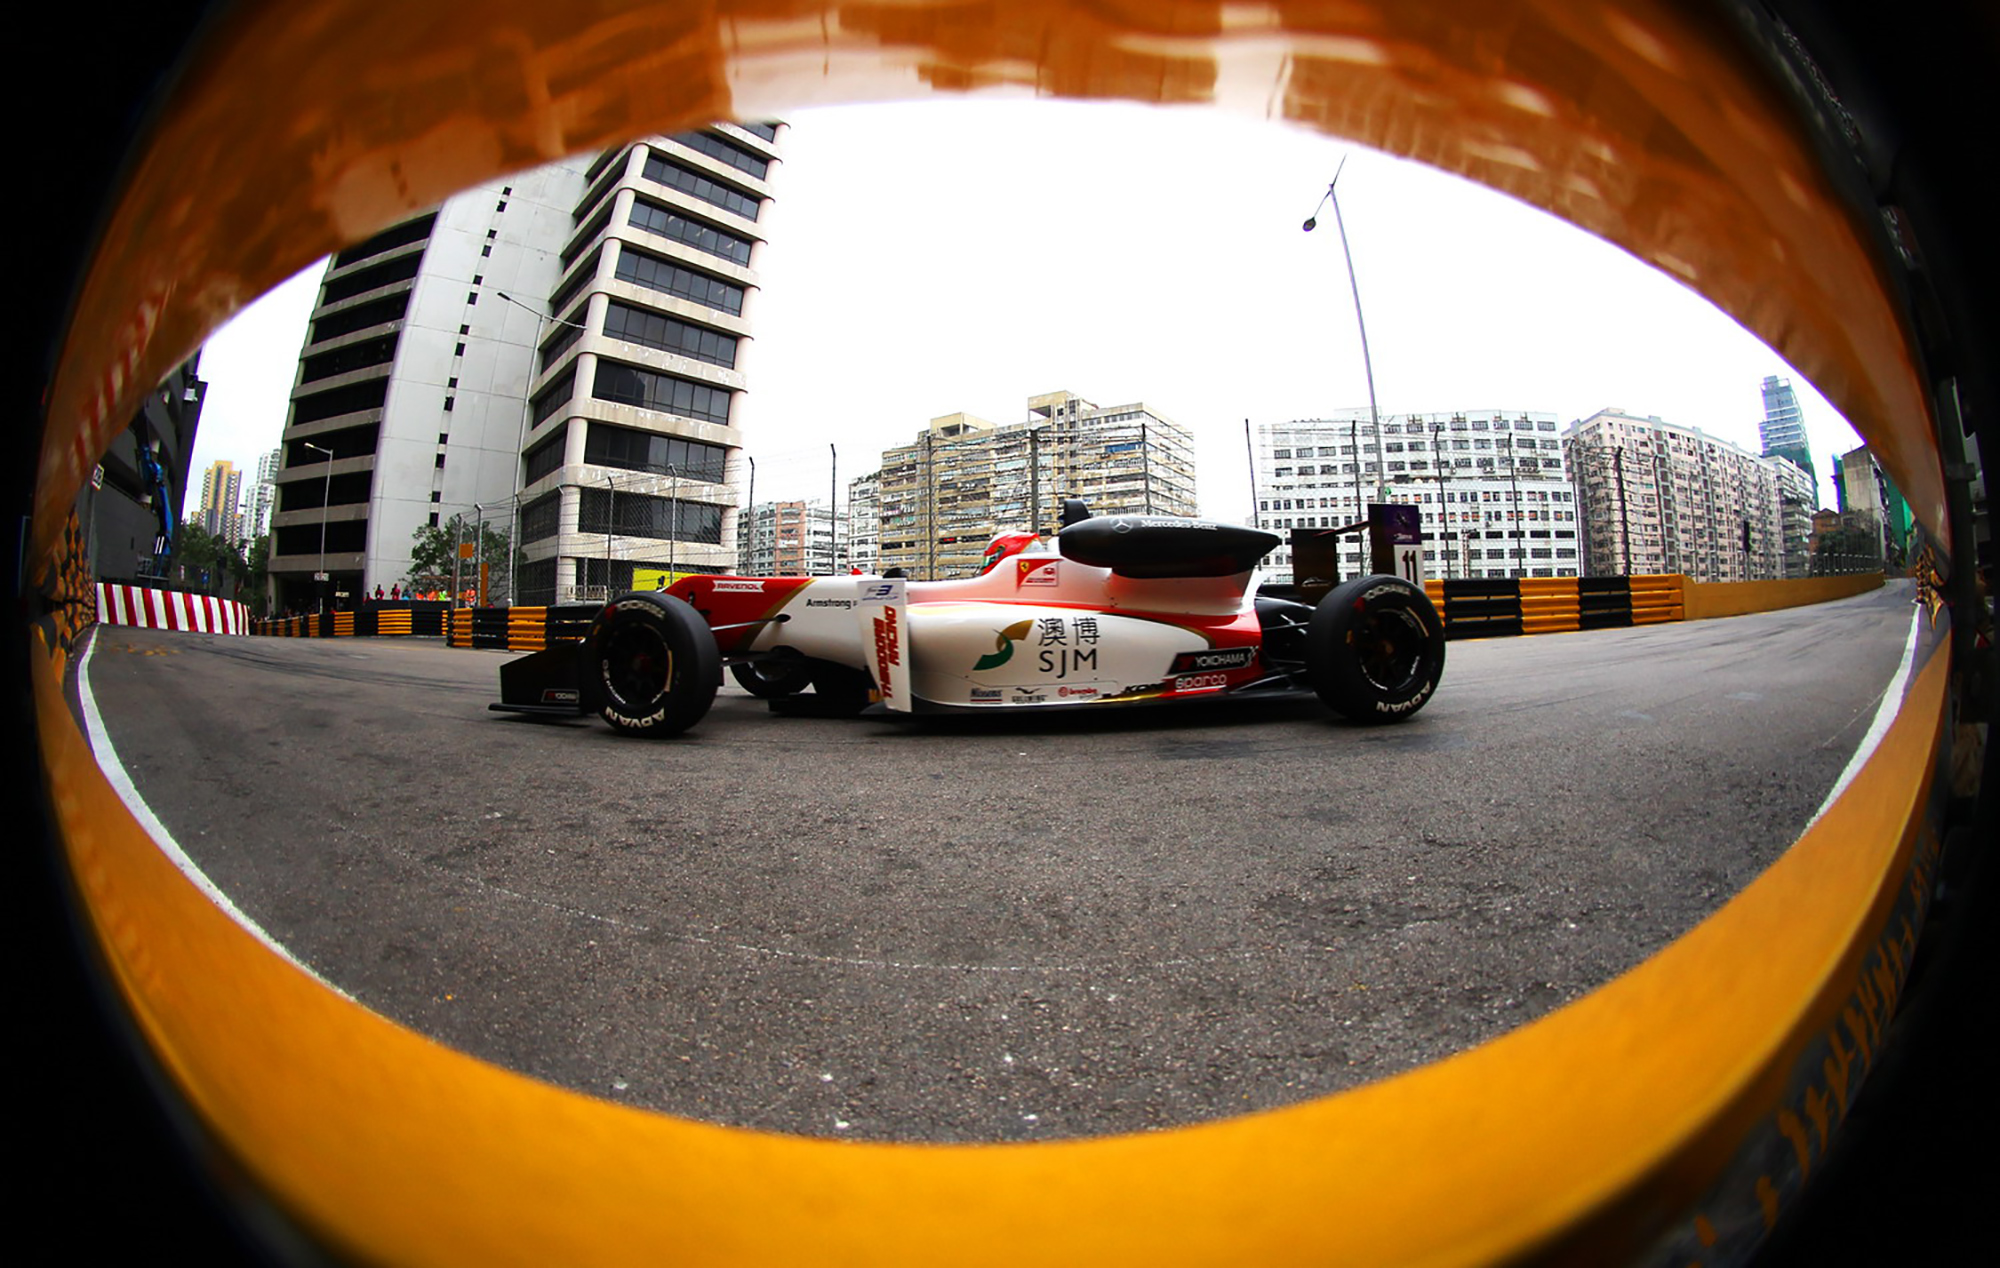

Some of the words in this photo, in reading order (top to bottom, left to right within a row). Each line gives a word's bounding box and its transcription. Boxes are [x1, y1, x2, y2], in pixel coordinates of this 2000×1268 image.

[1141, 519, 1218, 531] Mercedes-Benz
[1402, 550, 1418, 585] 11
[717, 582, 760, 590] RAVENOL
[806, 598, 852, 610] Armstrong
[884, 605, 900, 666] RACING
[1038, 617, 1100, 646] 澳博
[1039, 648, 1097, 679] SJM
[1195, 653, 1245, 667] YOKOHAMA
[1376, 680, 1431, 713] ADVAN
[605, 706, 665, 729] ADVAN
